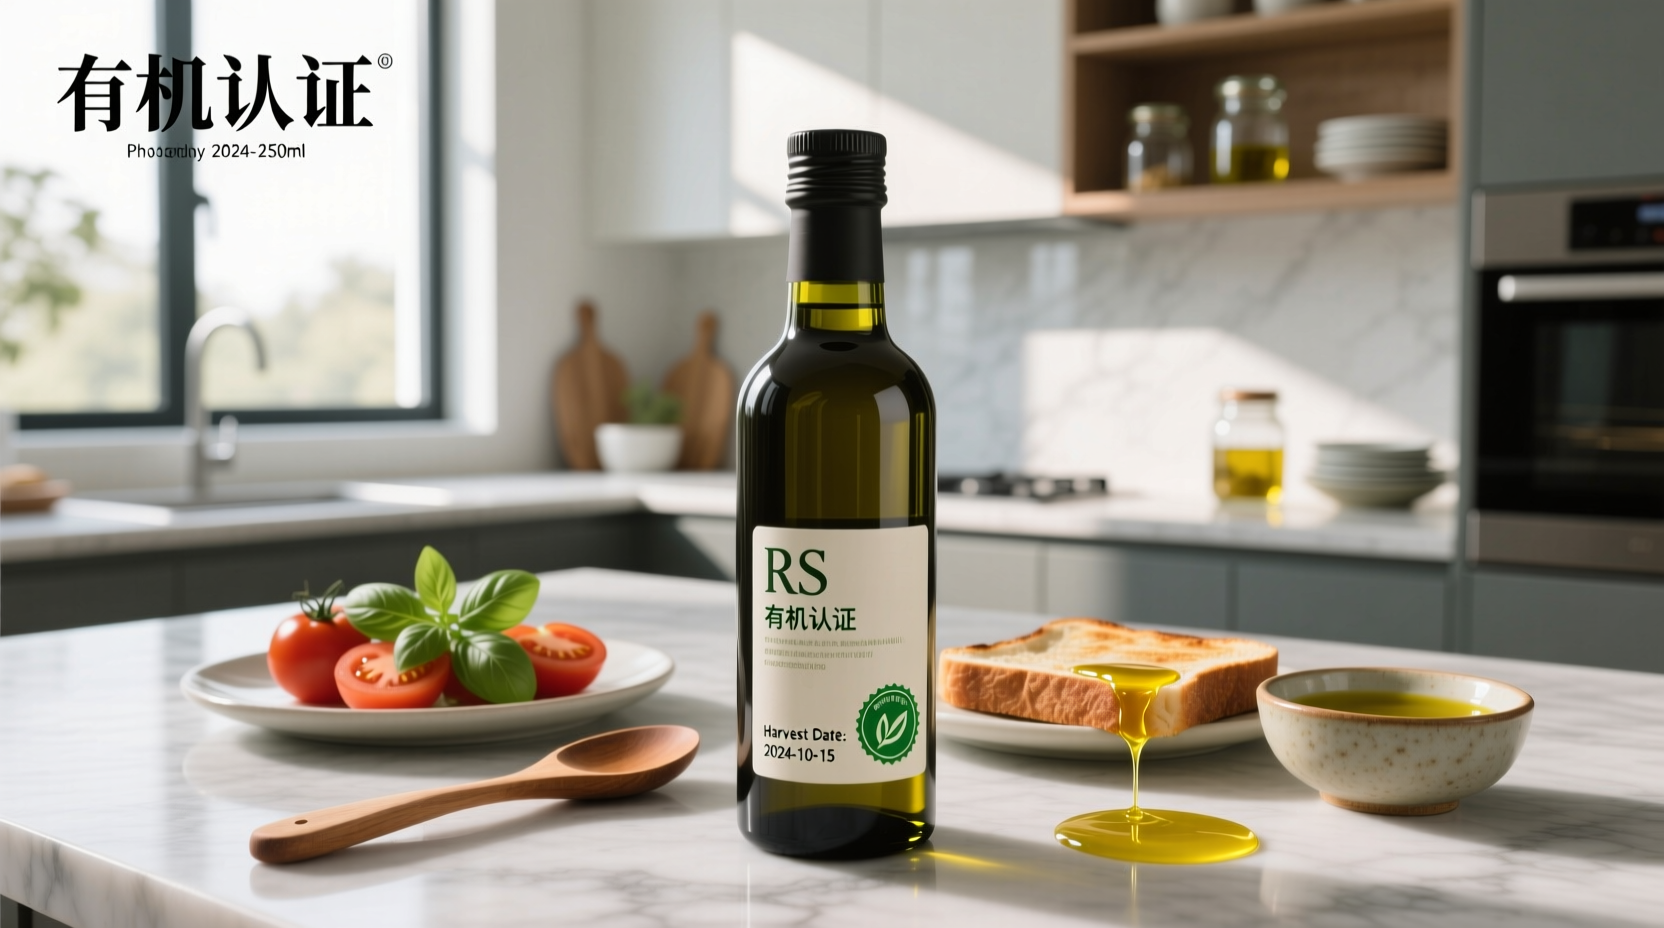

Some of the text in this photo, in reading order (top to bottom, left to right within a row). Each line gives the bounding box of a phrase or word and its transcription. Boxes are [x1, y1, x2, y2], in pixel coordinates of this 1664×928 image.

[765, 547, 827, 595] RS
[764, 604, 857, 631] 有机认证
[763, 724, 847, 742] Harvest Date:
[763, 744, 836, 763] 2024-10-15
